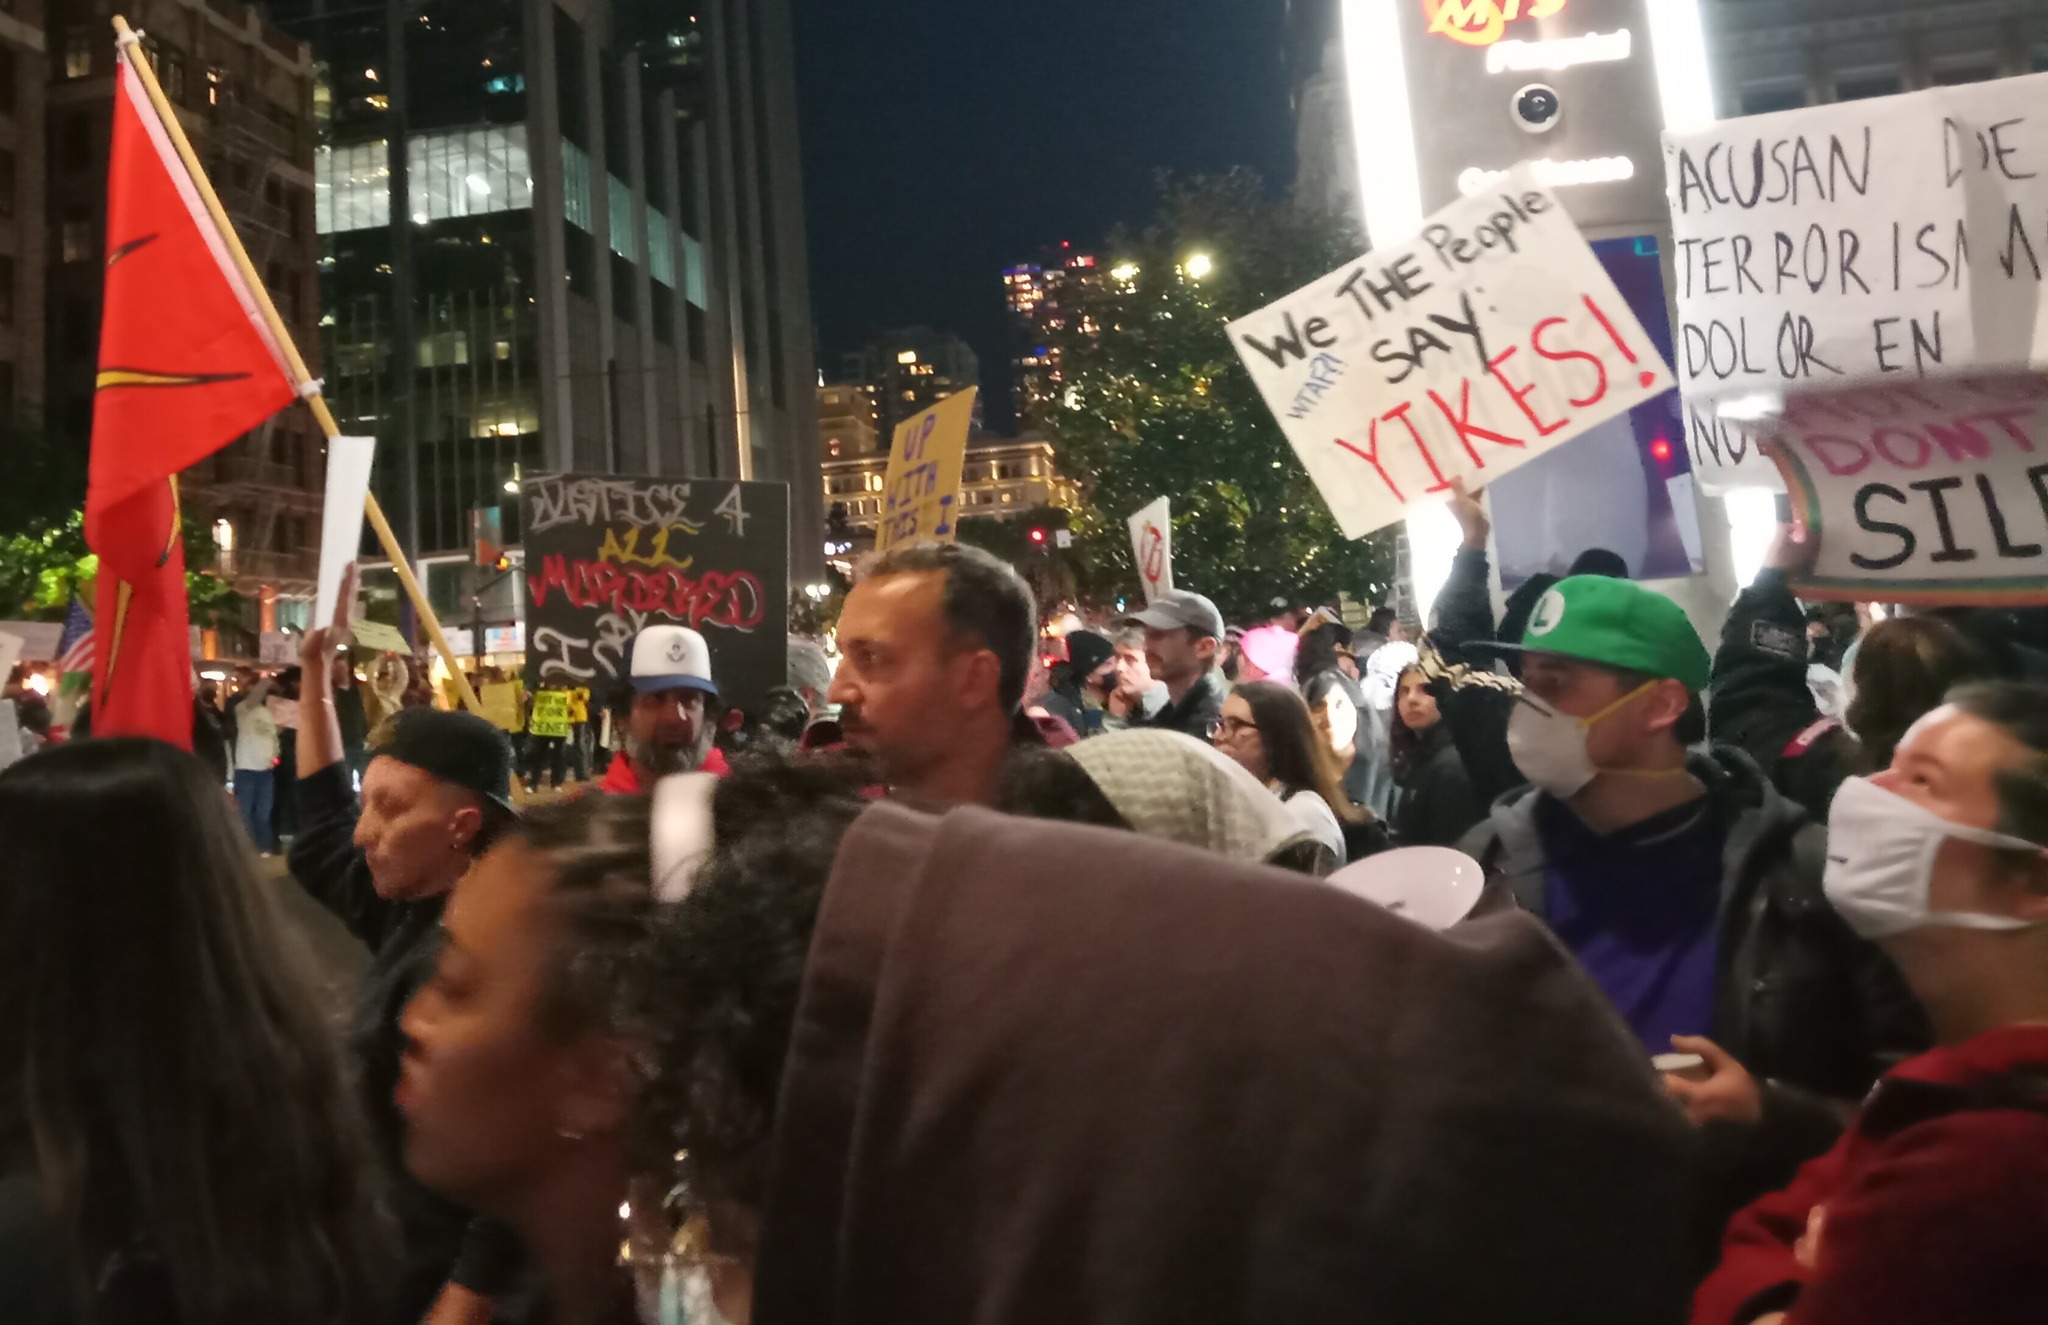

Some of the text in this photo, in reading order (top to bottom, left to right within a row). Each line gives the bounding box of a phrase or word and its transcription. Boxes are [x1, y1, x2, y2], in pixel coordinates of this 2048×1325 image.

[1679, 126, 1871, 214] ACUSAN
[1242, 190, 1551, 369] We THE People
[1683, 310, 1943, 380] DOLOR EN
[1334, 294, 1657, 503] YIKES!
[904, 414, 936, 461] UP
[522, 473, 750, 537] JUSTICE 4
[598, 523, 699, 569] ALL
[527, 553, 765, 633] MURDERED
[1533, 597, 1549, 627] L
